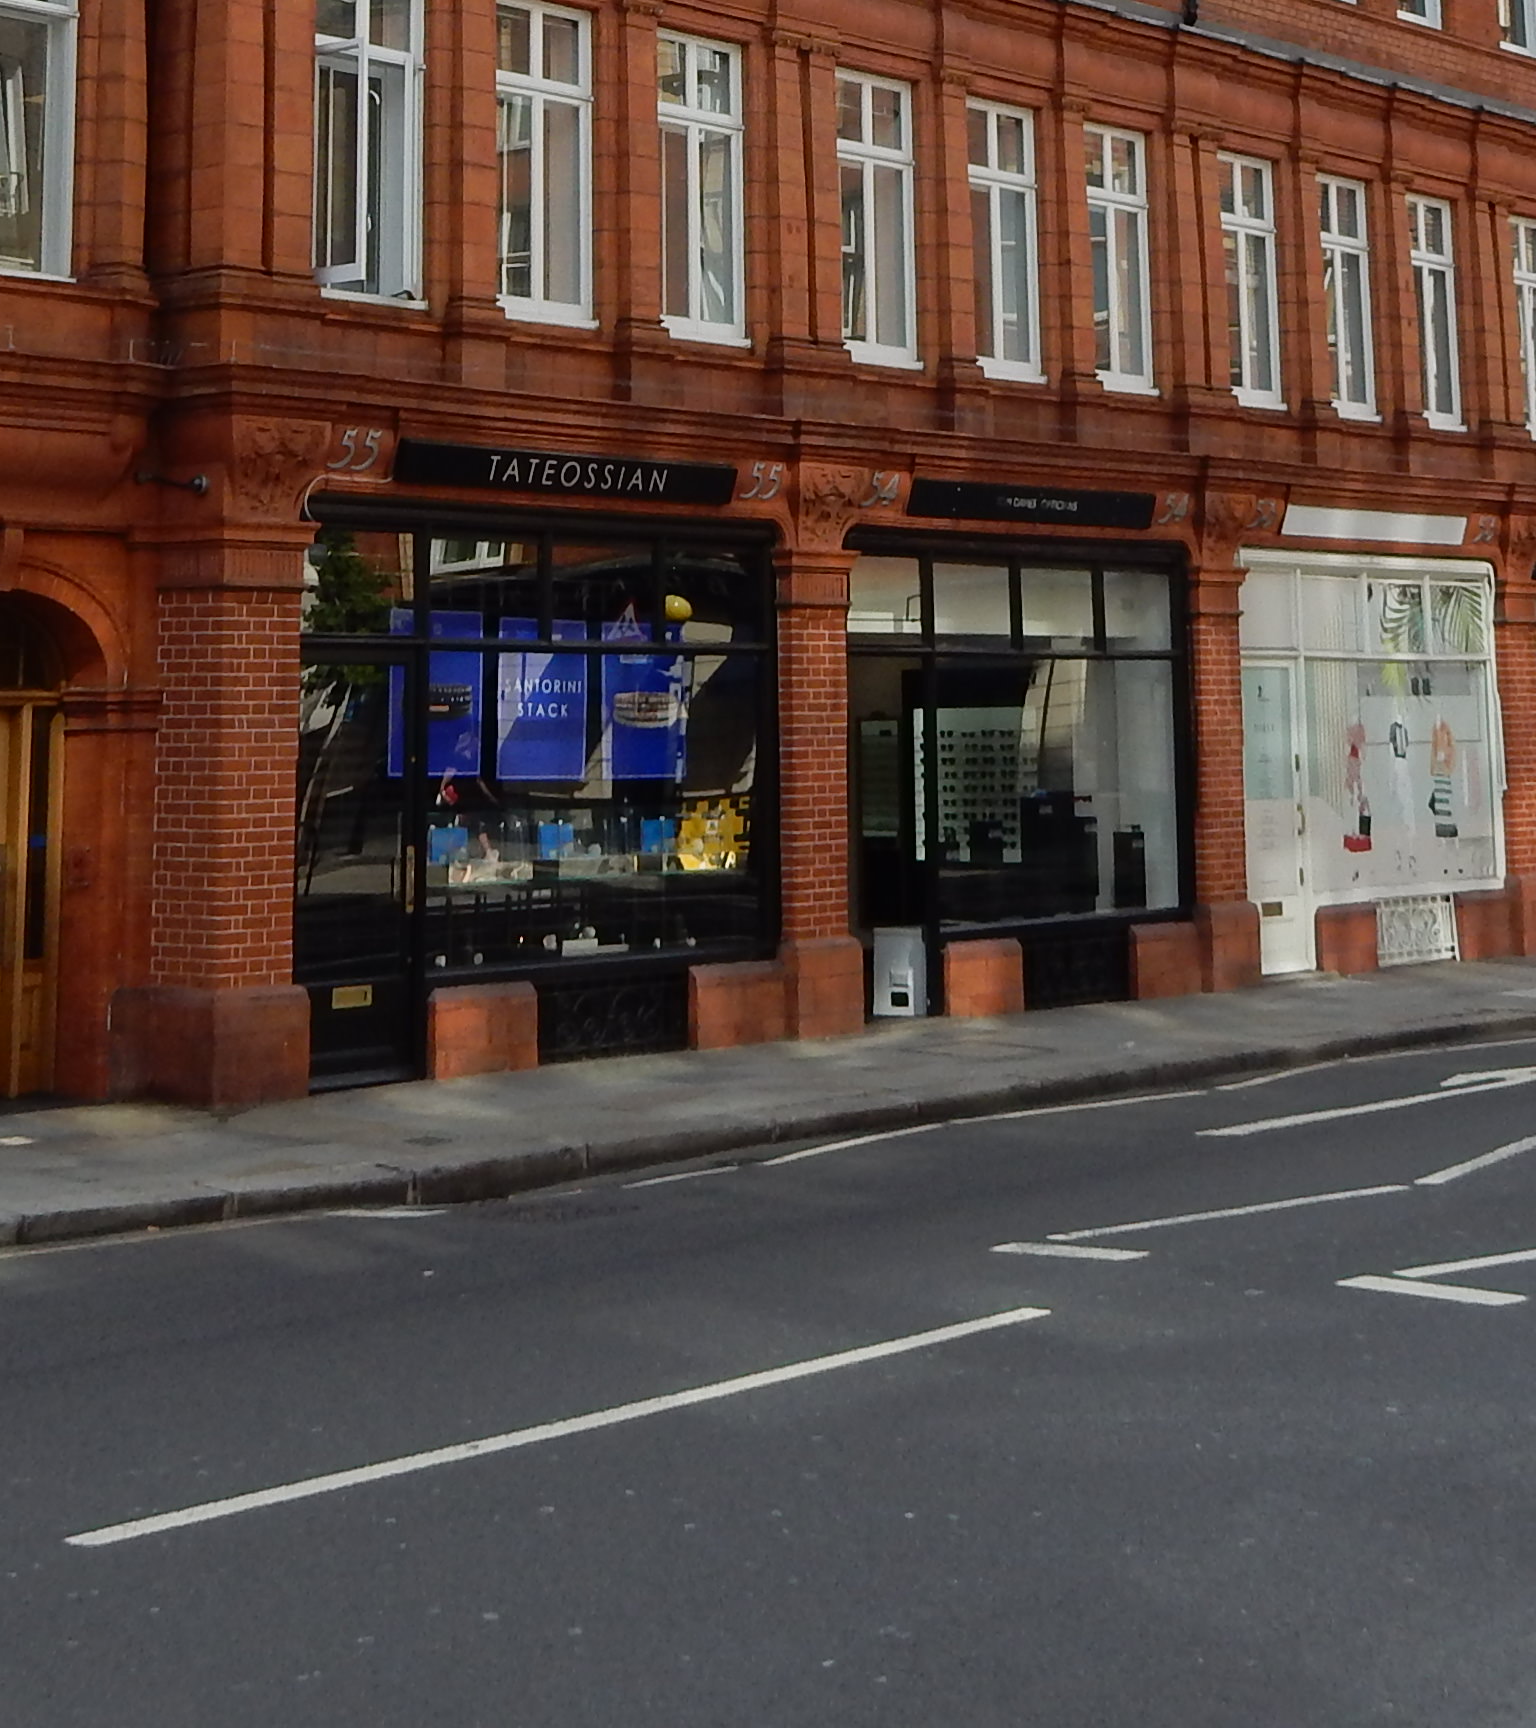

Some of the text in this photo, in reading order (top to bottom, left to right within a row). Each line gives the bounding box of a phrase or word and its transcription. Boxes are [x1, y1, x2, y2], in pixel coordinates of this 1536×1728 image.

[327, 426, 383, 471] 55
[488, 454, 669, 494] TATEOSSIAN
[740, 462, 784, 500] 55
[504, 677, 583, 694] SANTORINI
[517, 702, 569, 718] STACK
